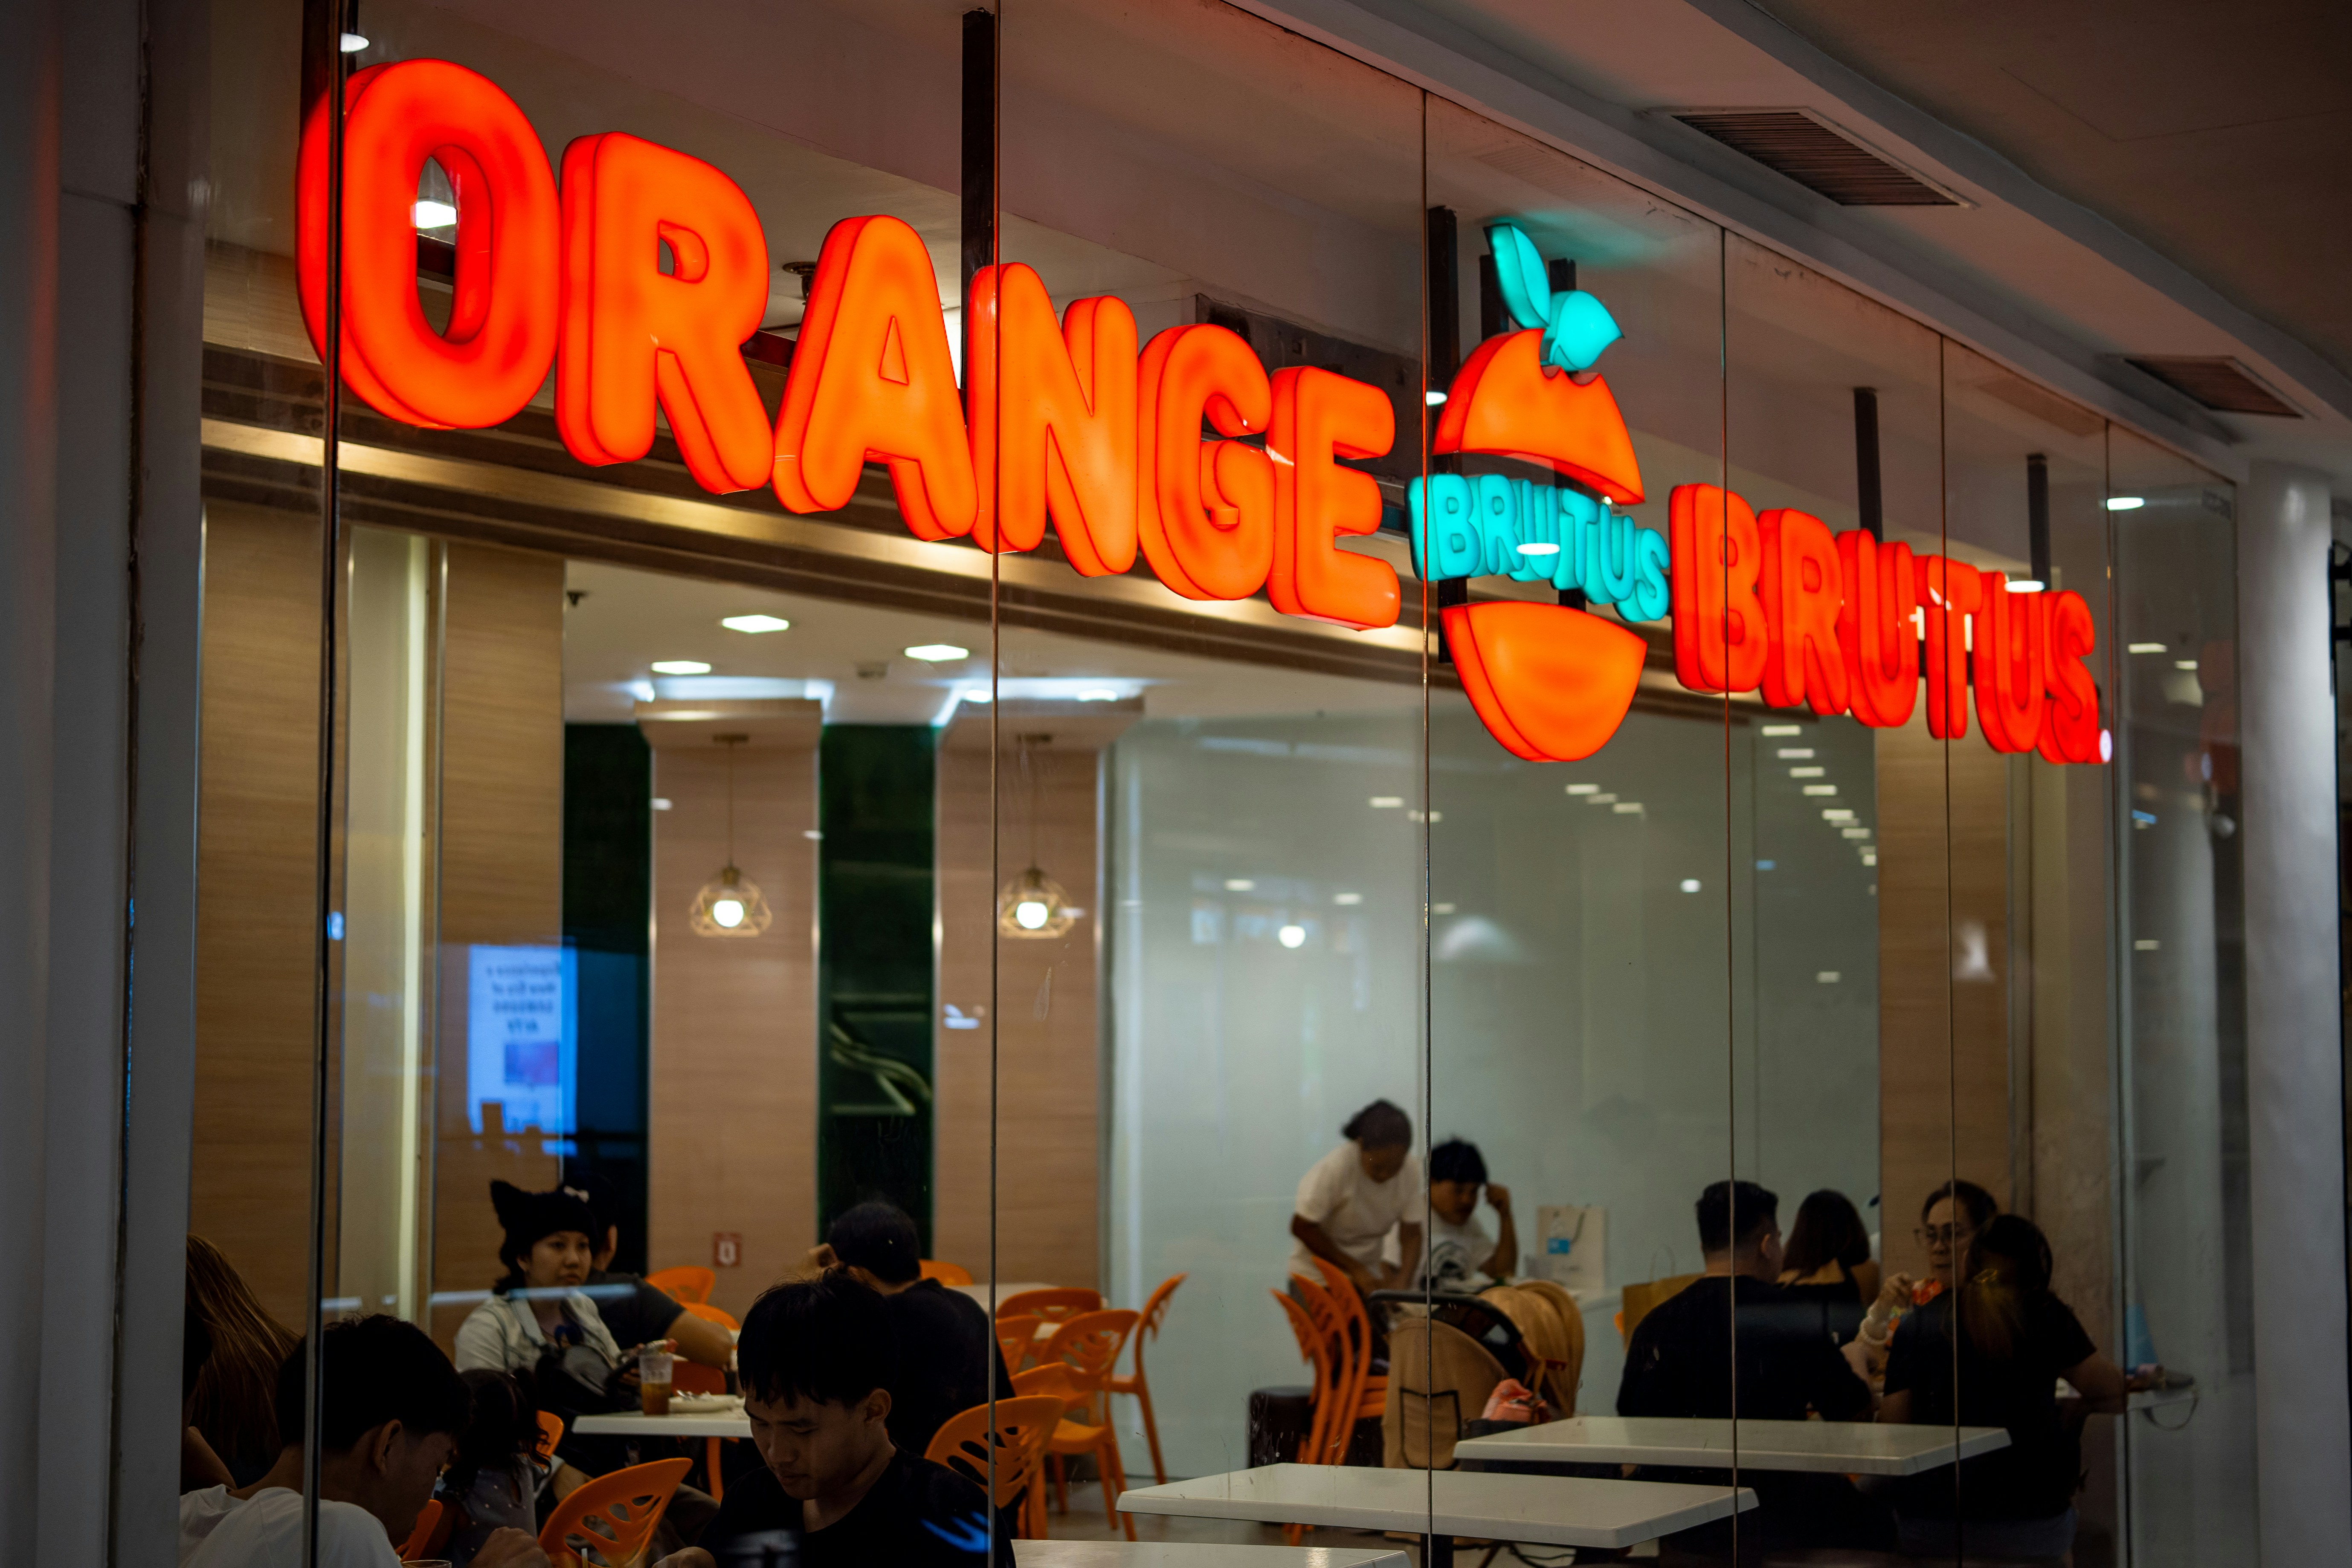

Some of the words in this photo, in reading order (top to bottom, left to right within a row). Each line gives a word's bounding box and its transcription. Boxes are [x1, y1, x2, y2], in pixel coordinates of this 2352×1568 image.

[296, 59, 1401, 631] ORANGE
[1405, 474, 1670, 622] BRUTUS
[1670, 483, 2100, 763] BRUTUS
